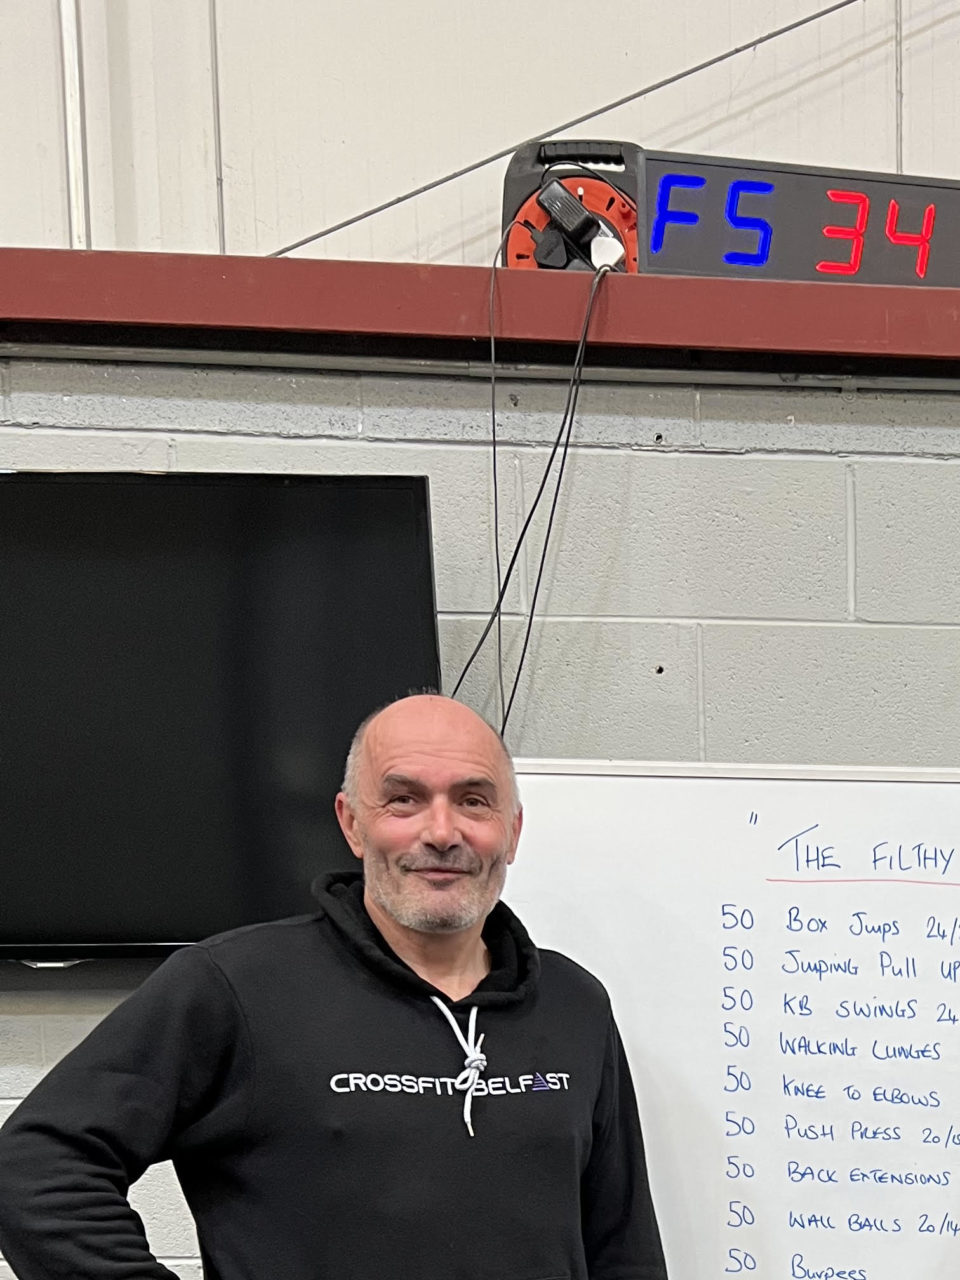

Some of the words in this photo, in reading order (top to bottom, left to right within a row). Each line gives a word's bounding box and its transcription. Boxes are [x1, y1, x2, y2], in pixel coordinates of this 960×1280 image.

[816, 189, 936, 279] 34
[872, 842, 955, 876] FILTHY
[721, 903, 755, 931] 50
[786, 905, 828, 933] Box
[721, 945, 755, 972] 50
[879, 950, 918, 978] Pull
[721, 985, 755, 1012] 50
[783, 992, 814, 1018] KB
[723, 1021, 751, 1048] 50
[779, 1031, 859, 1057] WALKING
[330, 1073, 453, 1096] CROSSFIT
[723, 1064, 753, 1093] 50
[782, 1073, 828, 1100] KNEE
[871, 1086, 942, 1108] ELBOWS
[724, 1111, 756, 1137] 50
[725, 1156, 756, 1180] 50
[786, 1160, 839, 1184] BACK
[848, 1167, 952, 1187] EXTENSIONS
[726, 1200, 756, 1228] 50
[724, 1248, 757, 1273] 50
